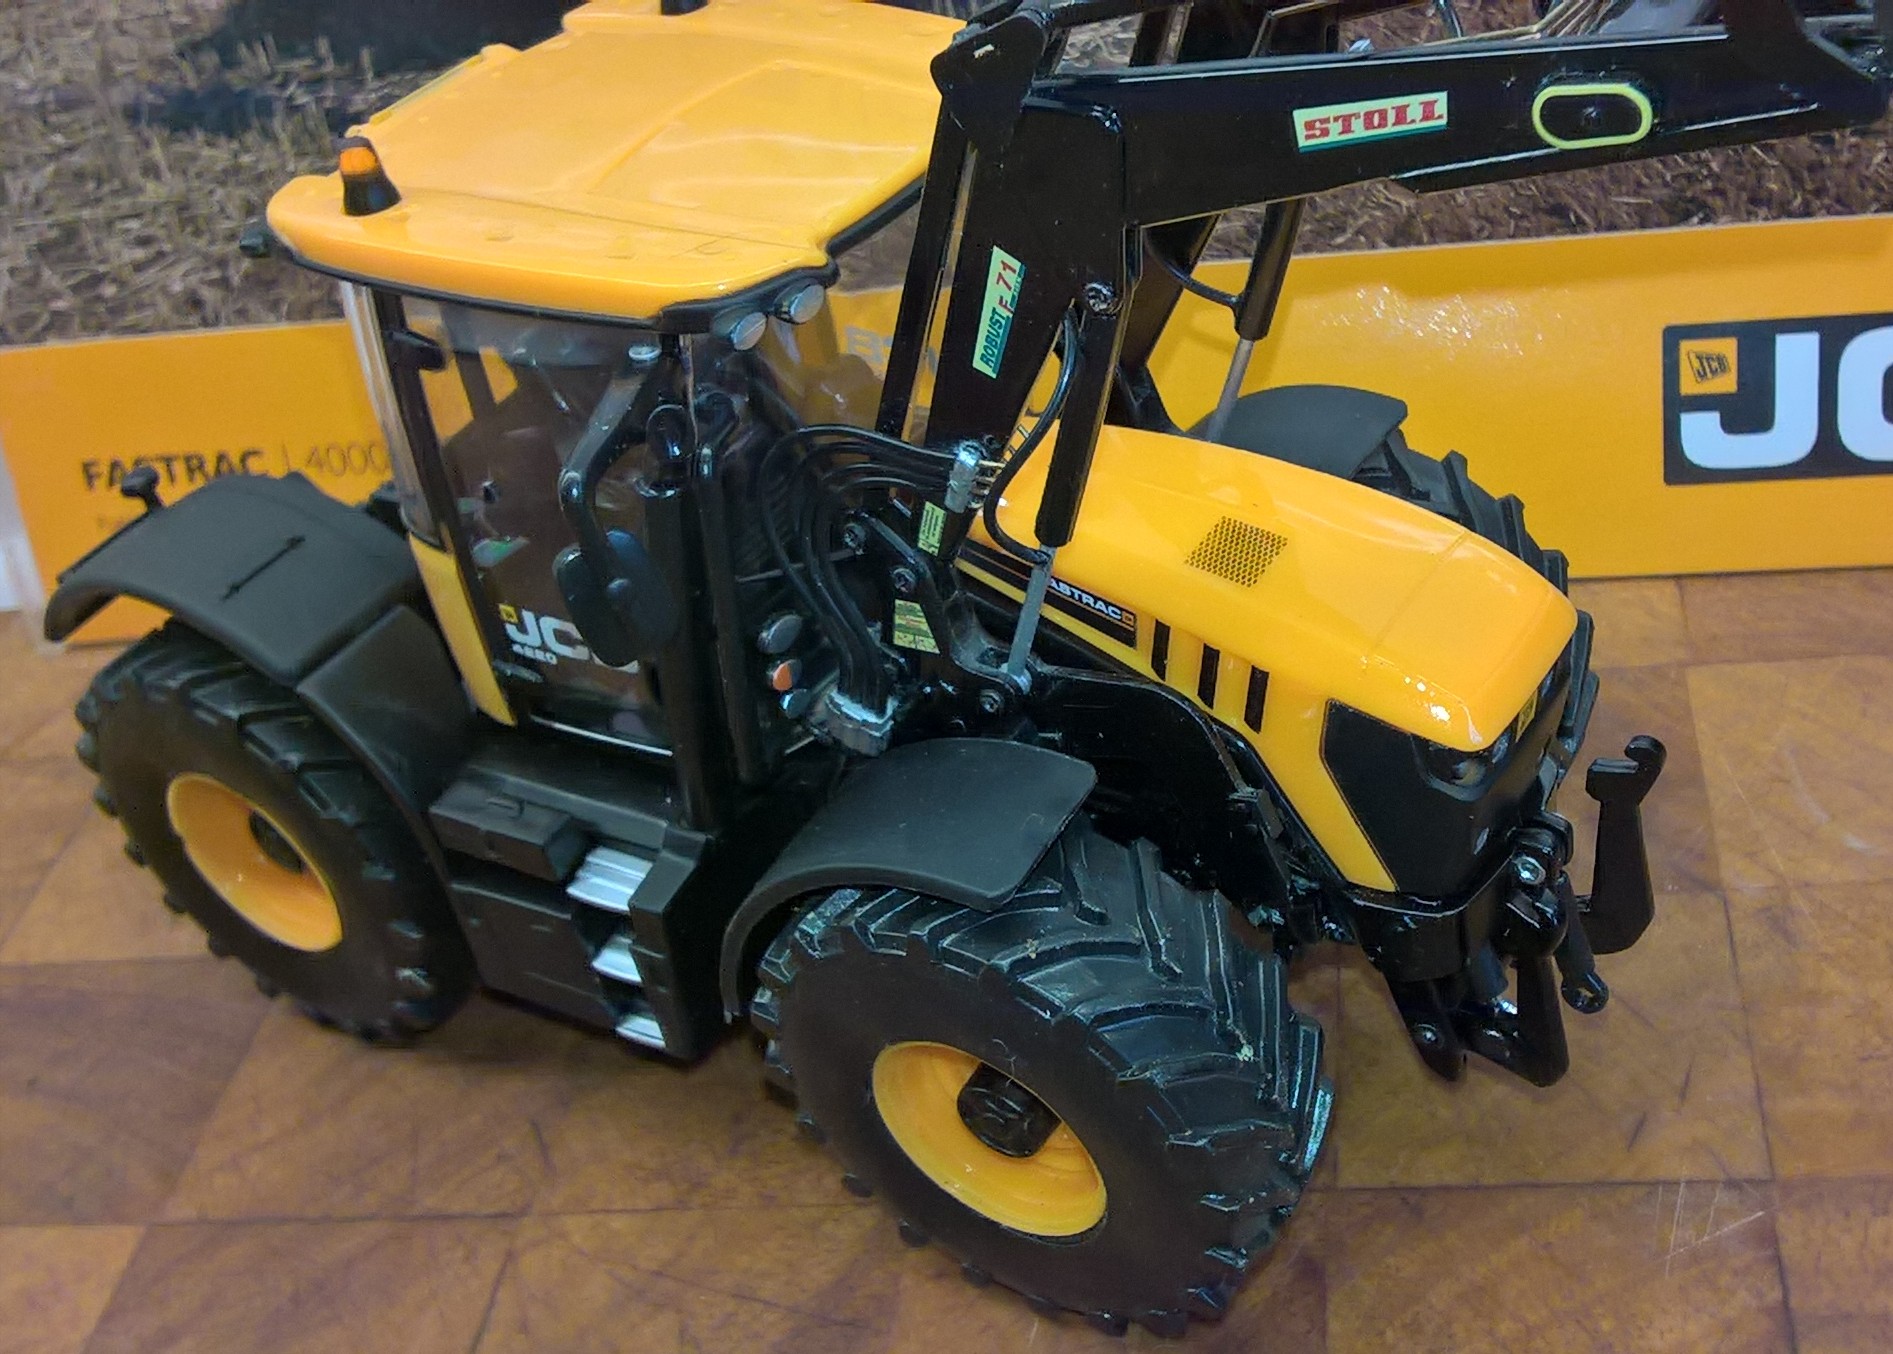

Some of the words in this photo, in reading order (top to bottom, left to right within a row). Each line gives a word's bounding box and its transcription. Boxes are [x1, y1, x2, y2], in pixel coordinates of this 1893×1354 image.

[1304, 98, 1444, 141] STOLL
[996, 259, 1017, 292] 71
[998, 295, 1015, 315] F
[980, 307, 1007, 369] ROBUST
[1048, 577, 1122, 620] ASTRAC
[504, 608, 641, 674] JC
